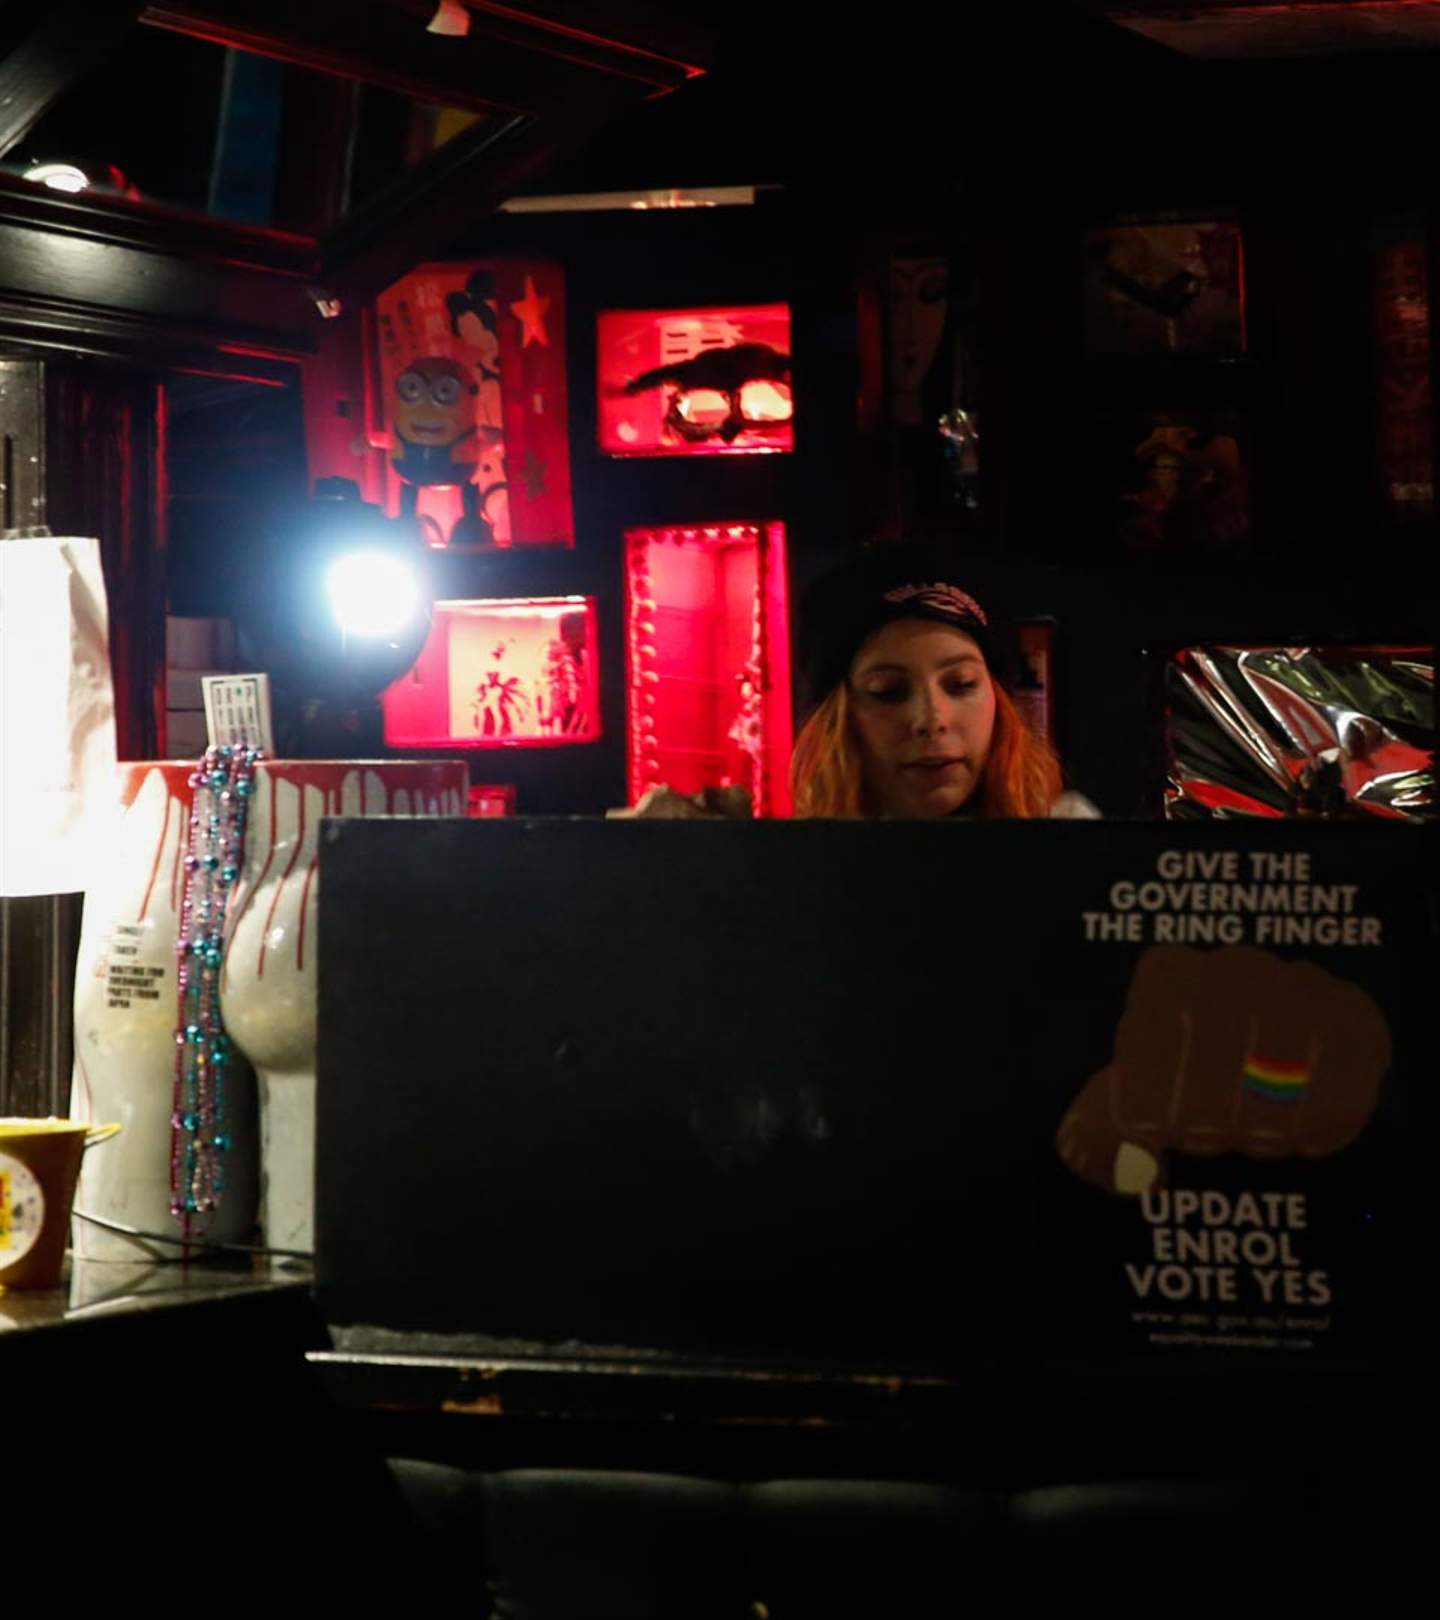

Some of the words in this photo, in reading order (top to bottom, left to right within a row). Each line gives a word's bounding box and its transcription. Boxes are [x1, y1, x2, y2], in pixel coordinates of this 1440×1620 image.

[1156, 849, 1240, 880] GIVE
[1248, 850, 1313, 882] THE
[1108, 880, 1361, 914] GOVERNMENT
[1081, 911, 1145, 943] THE
[1152, 914, 1244, 944] RING
[1254, 915, 1384, 947] FINGER
[1138, 1189, 1309, 1230] UPDATE
[1151, 1228, 1302, 1266] ENROL
[1123, 1263, 1239, 1302] VOTE
[1251, 1268, 1333, 1308] YES
